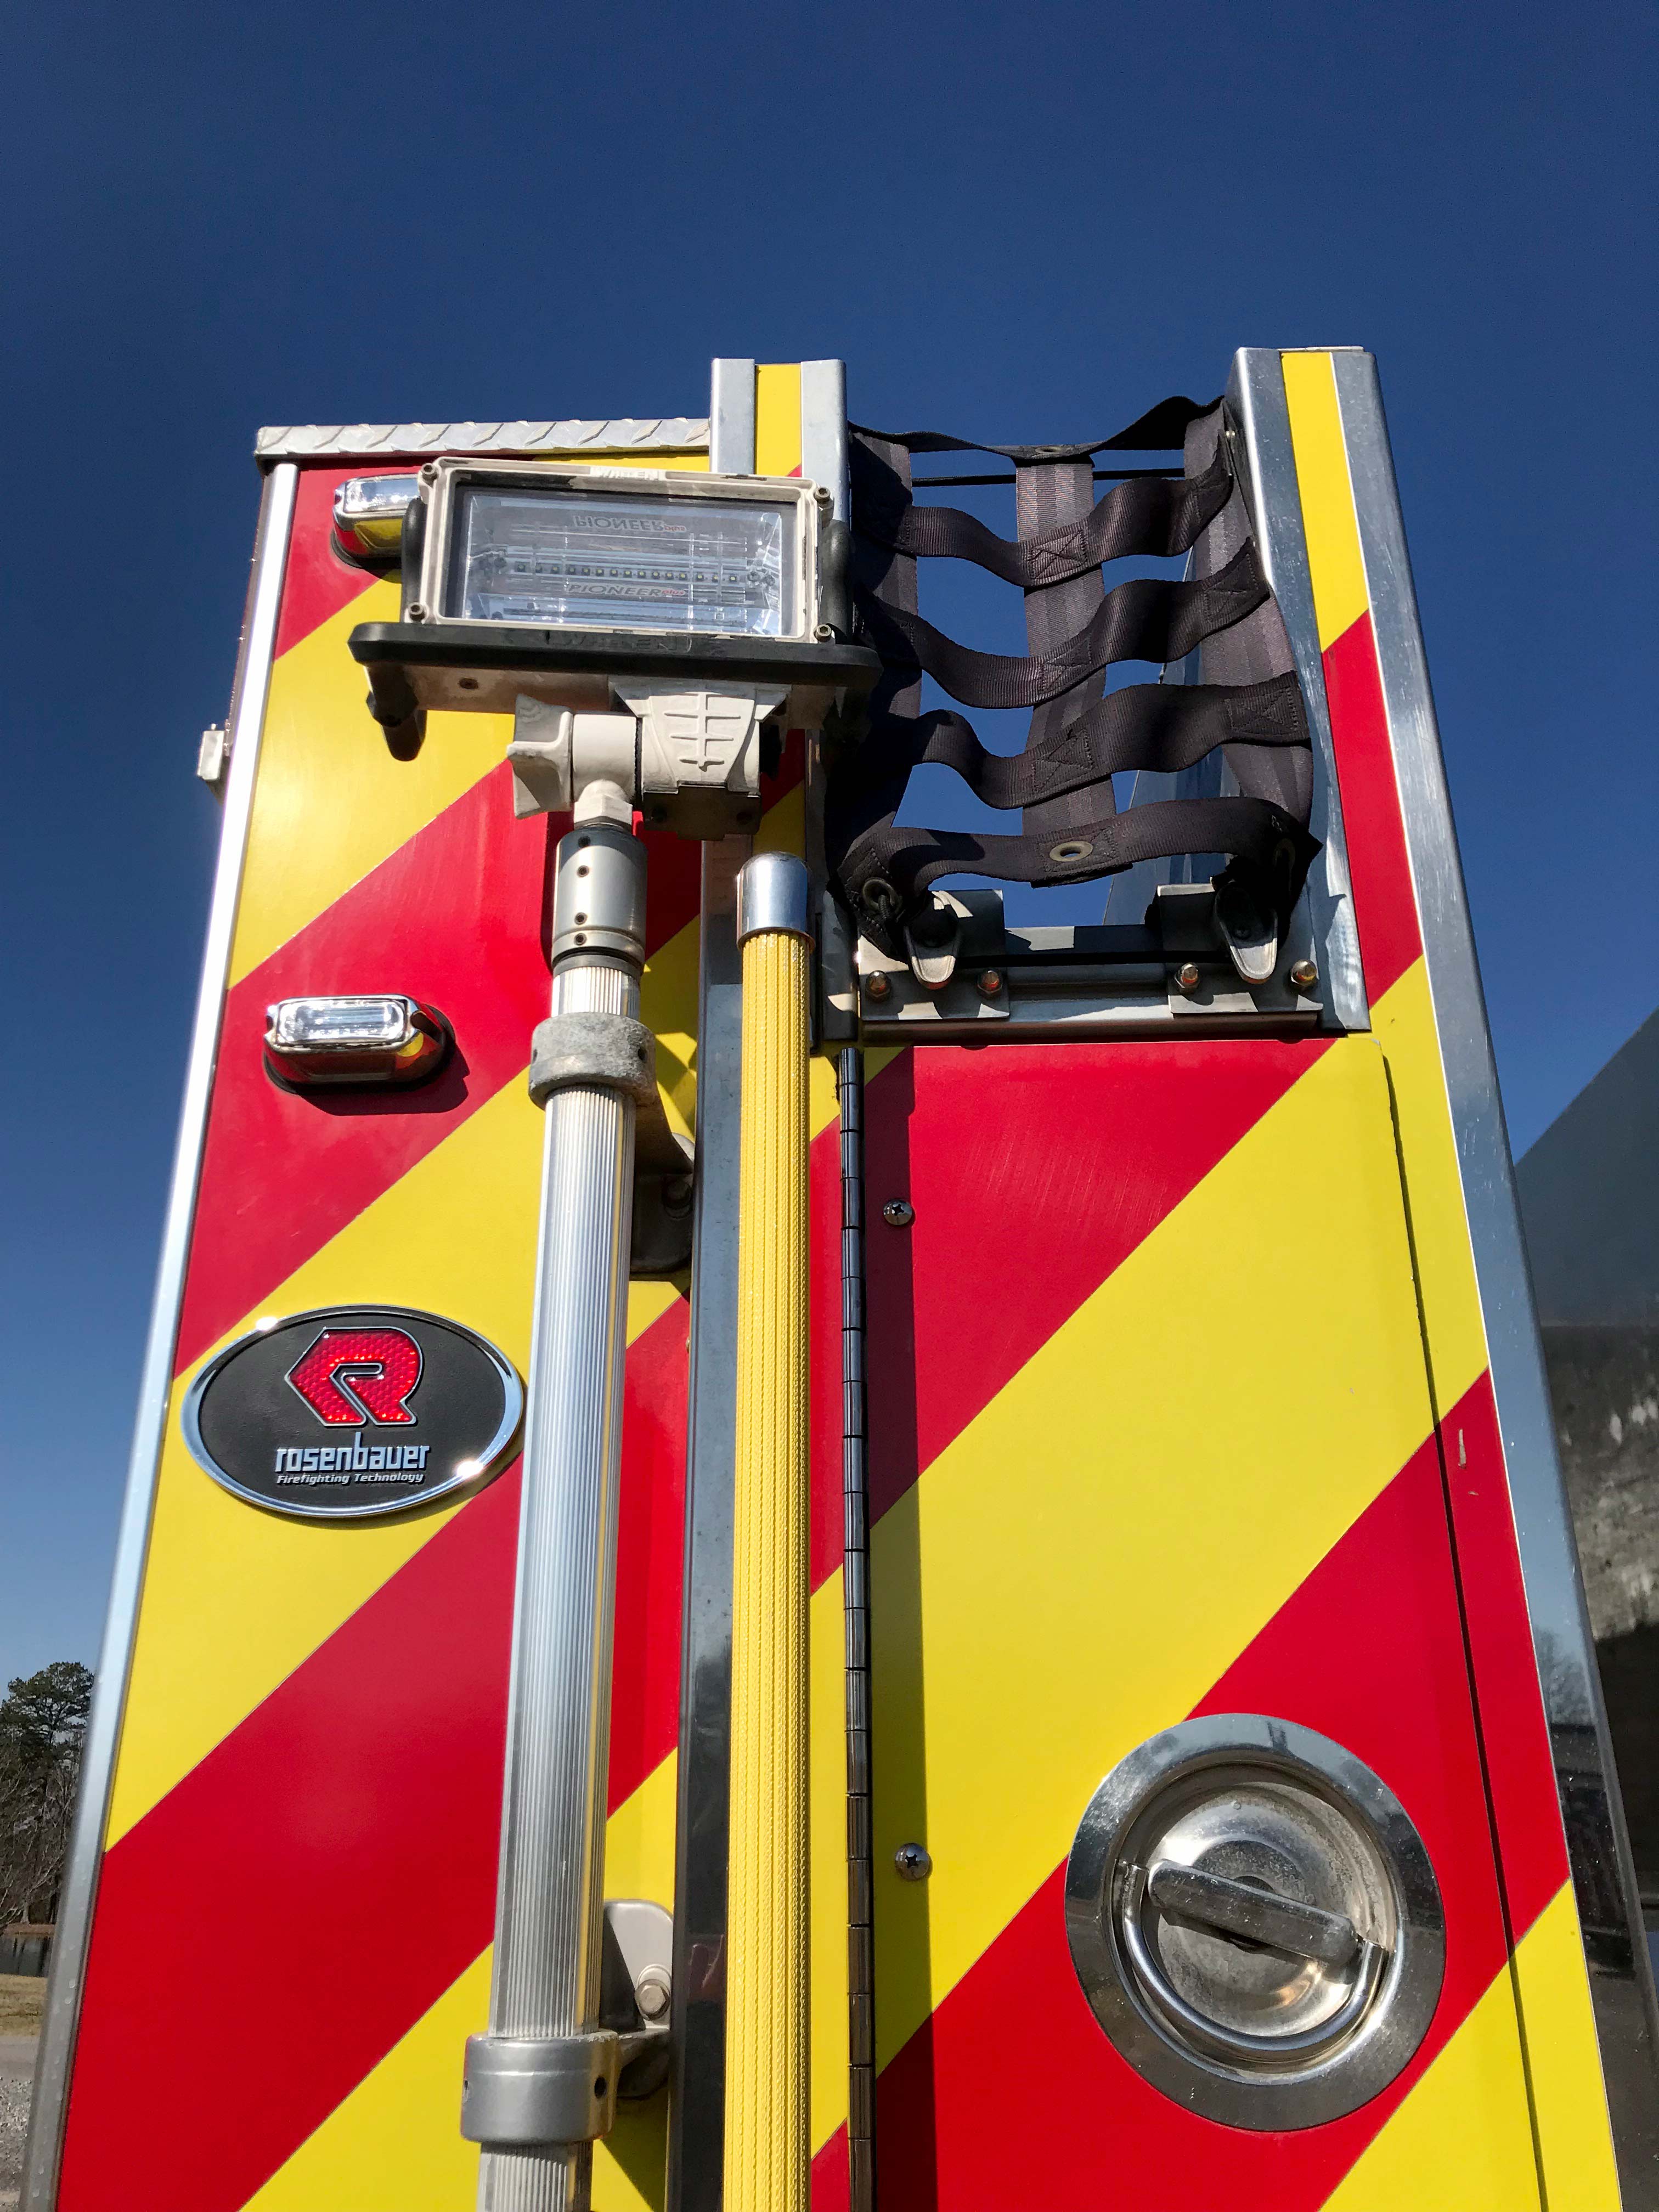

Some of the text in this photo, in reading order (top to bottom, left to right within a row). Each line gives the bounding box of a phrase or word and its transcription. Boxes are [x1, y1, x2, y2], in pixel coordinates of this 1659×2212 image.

[568, 584, 661, 597] PIONEER
[275, 1431, 430, 1471] rosenbauer
[276, 1472, 424, 1485] Firefighting Technology
